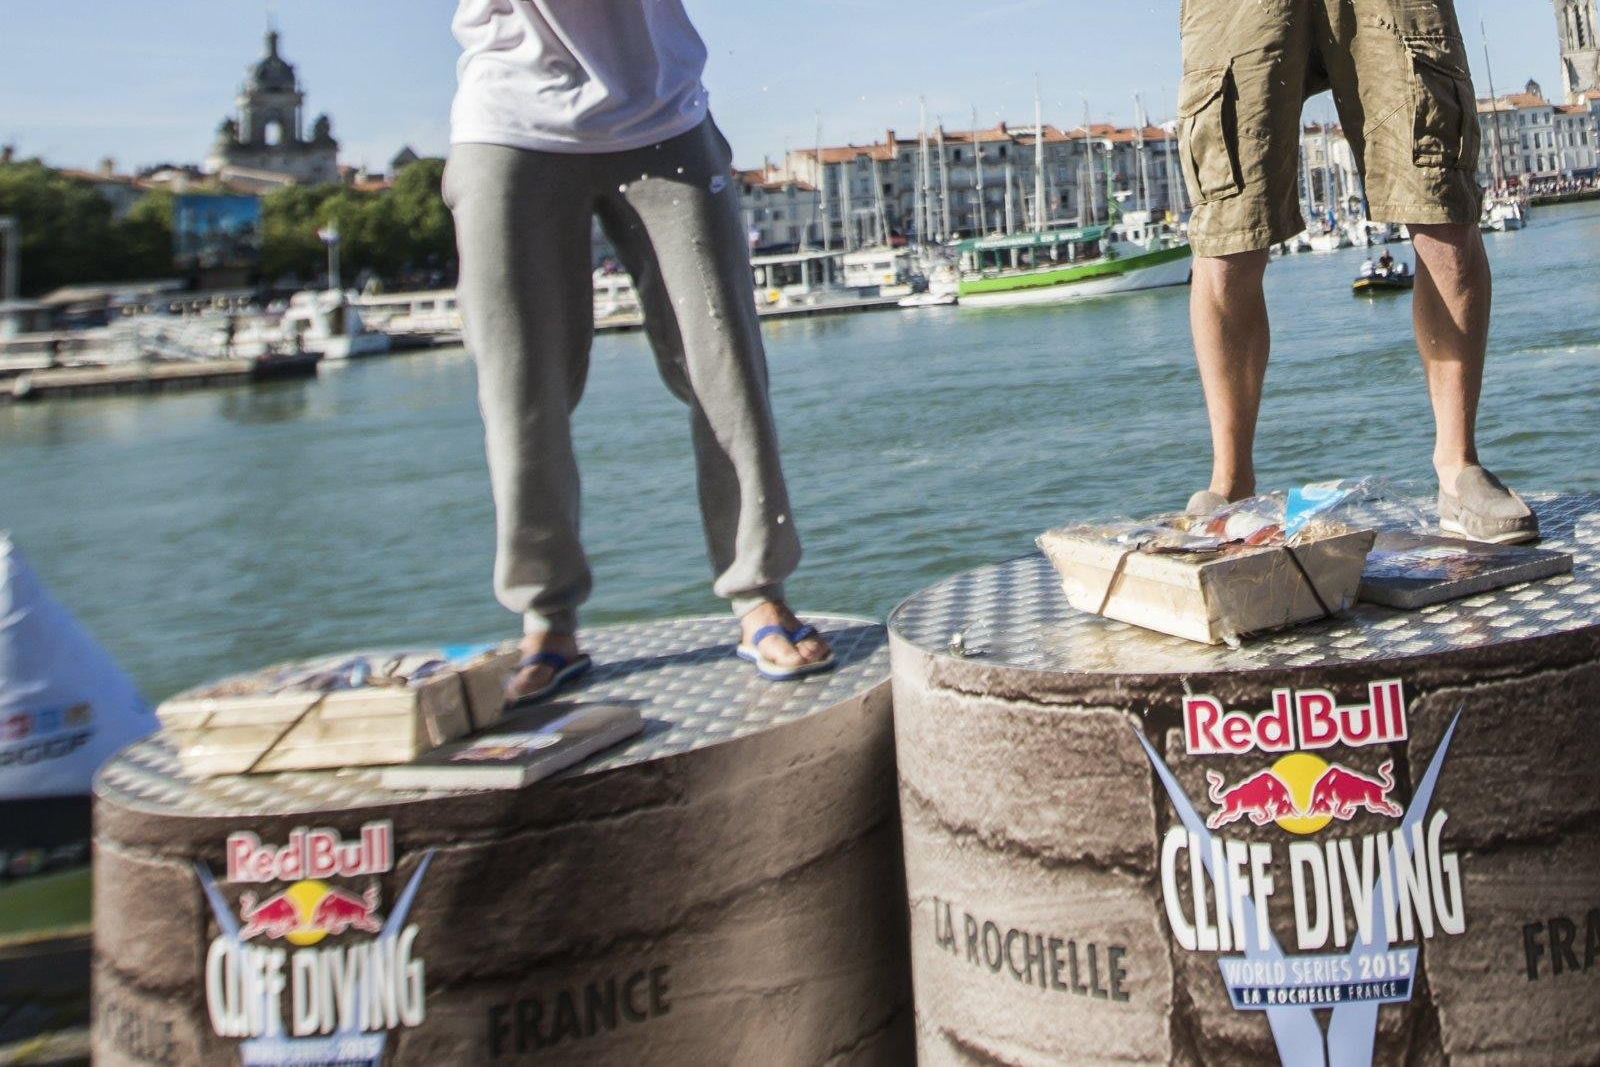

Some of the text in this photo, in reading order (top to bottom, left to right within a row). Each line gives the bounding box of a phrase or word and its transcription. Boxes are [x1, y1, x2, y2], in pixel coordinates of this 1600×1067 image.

[1185, 681, 1406, 752] Red Bull
[227, 823, 391, 881] Red Bull
[1161, 809, 1466, 951] CLIFF DIVING
[205, 923, 425, 1037] CLIFF DIVING
[932, 895, 1131, 1003] LA ROCHELLE
[1225, 951, 1411, 986] WORLD SERIES 2015
[488, 964, 672, 1059] FRANCE
[1242, 980, 1398, 1004] LA ROCHELLE FRANCE
